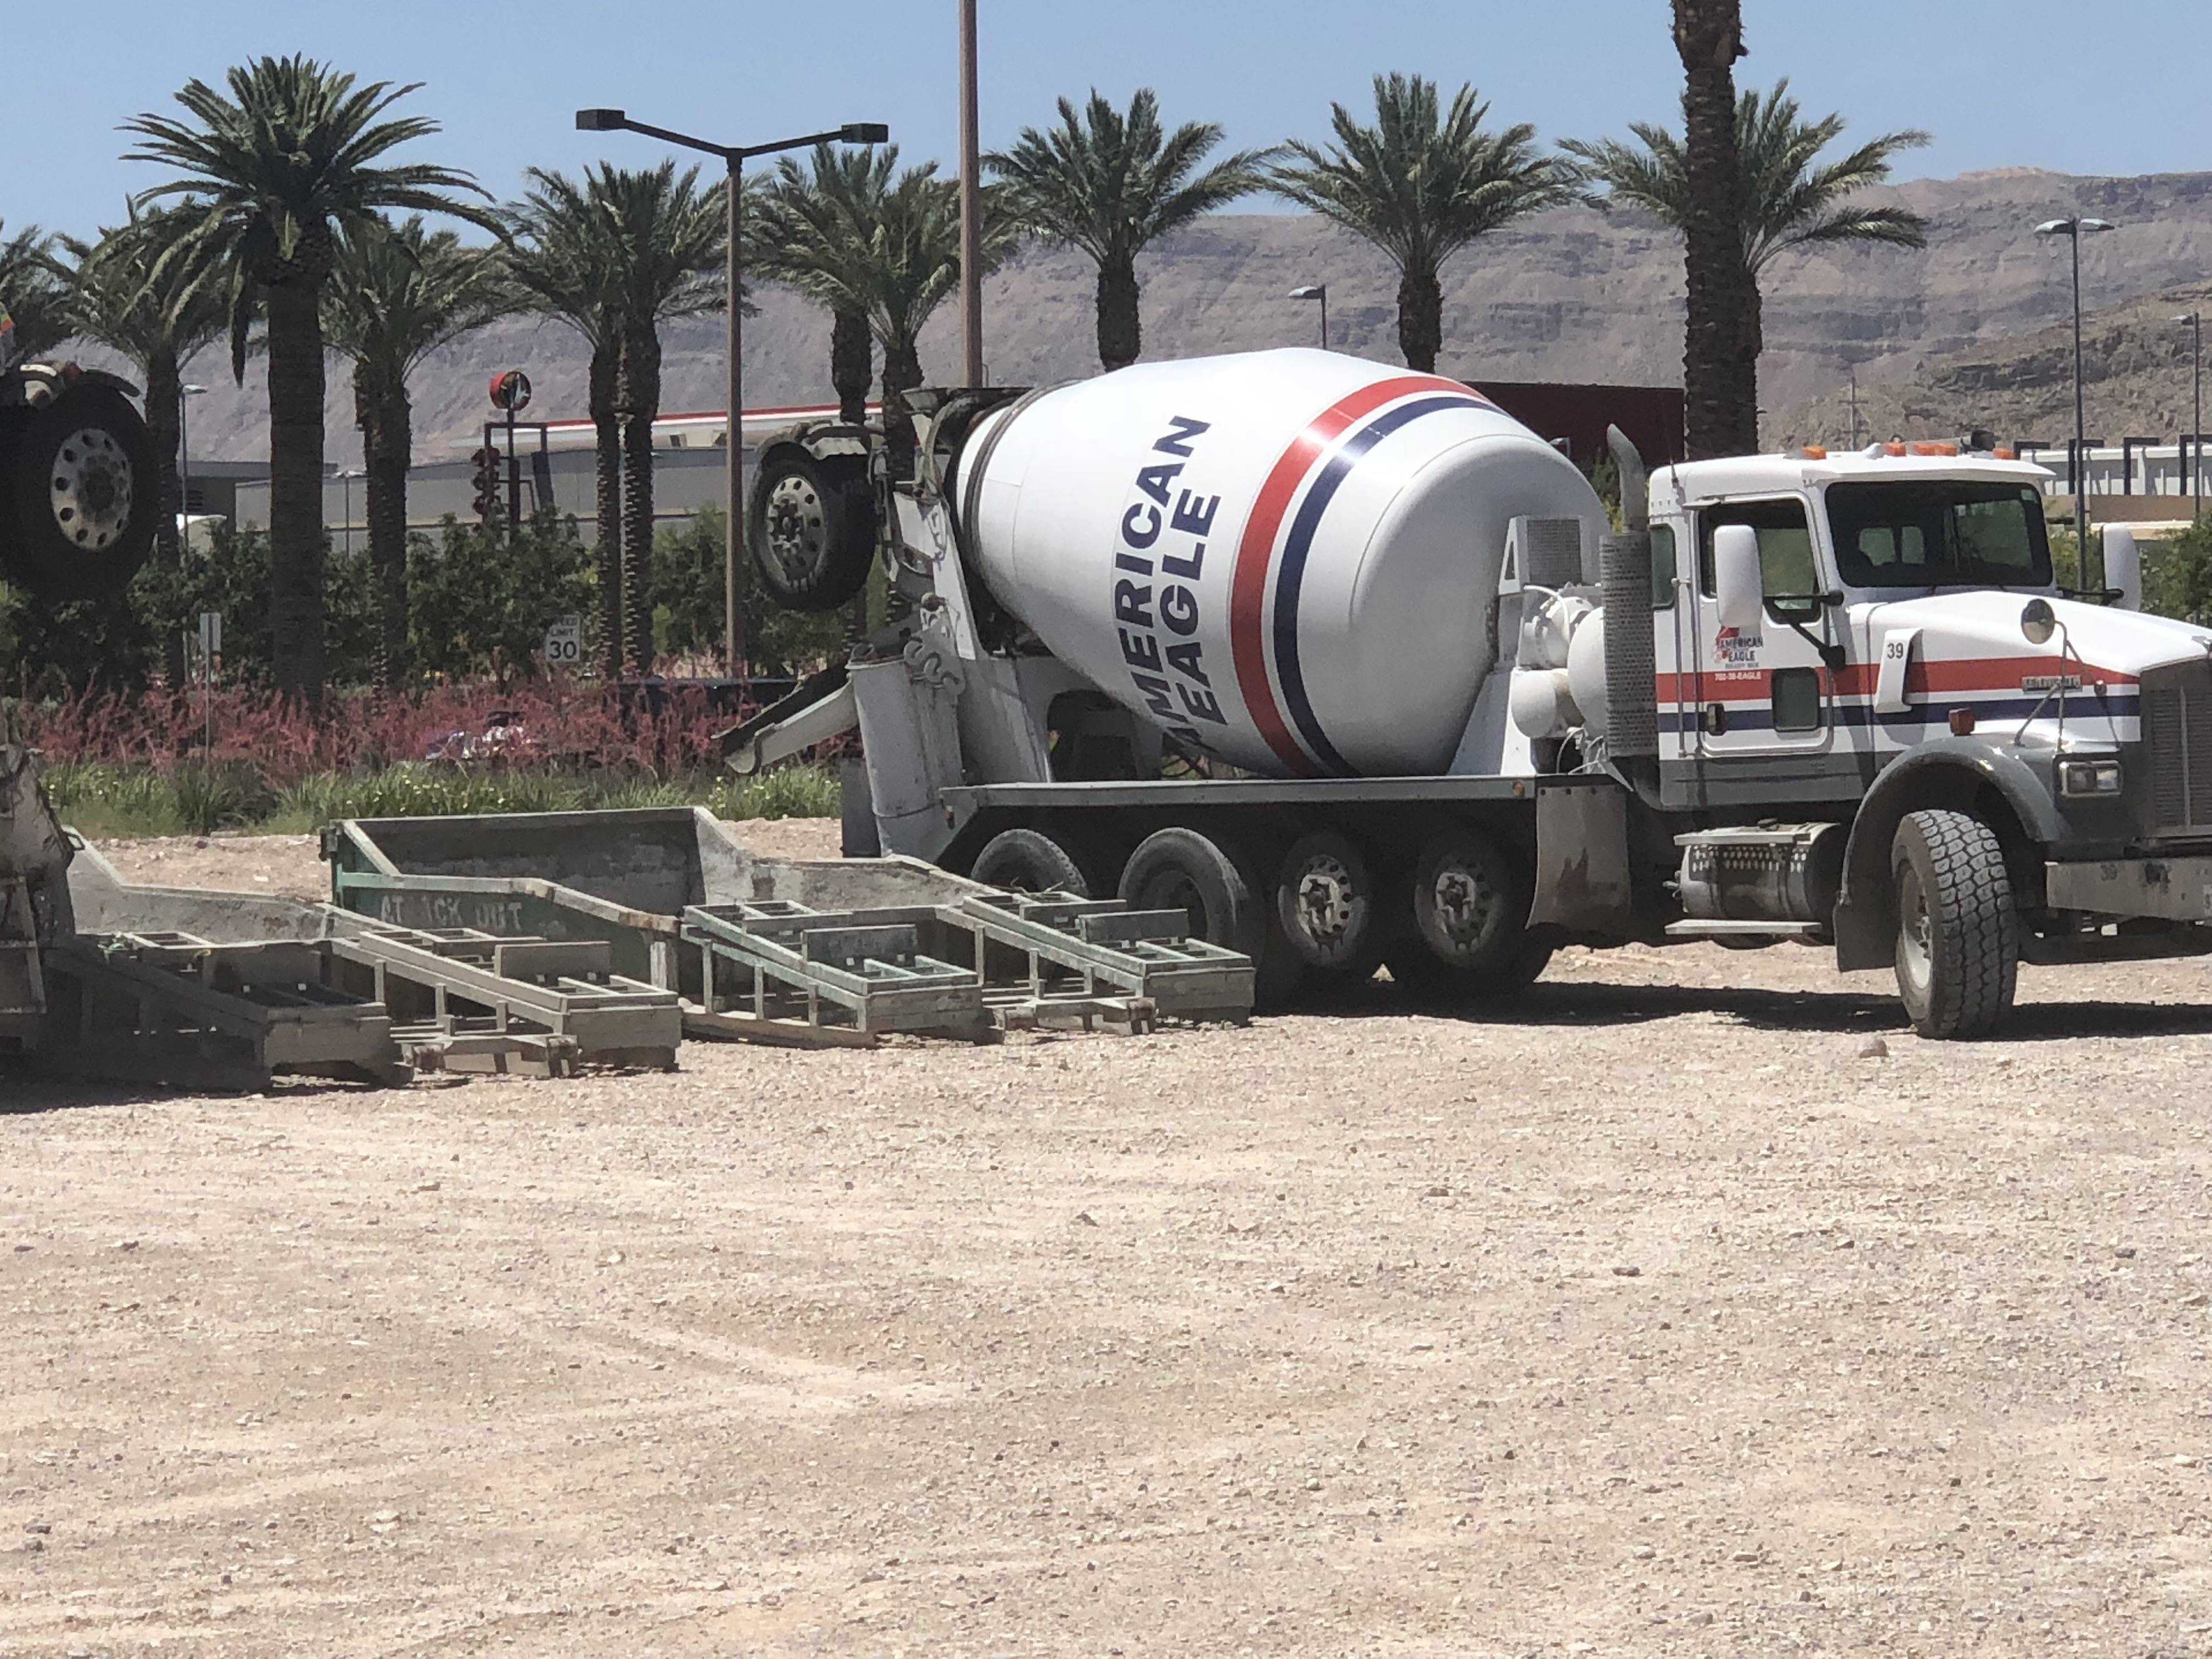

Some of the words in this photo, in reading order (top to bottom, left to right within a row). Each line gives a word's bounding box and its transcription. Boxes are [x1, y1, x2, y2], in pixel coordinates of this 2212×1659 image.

[1114, 415, 1219, 753] AMERICAN
[1159, 488, 1228, 726] EAGLE
[551, 628, 574, 637] LIMIT
[550, 641, 577, 659] 30
[1717, 637, 1763, 648] AMERICAN
[1887, 642, 1904, 659] 39
[1729, 651, 1756, 662] EAGLE
